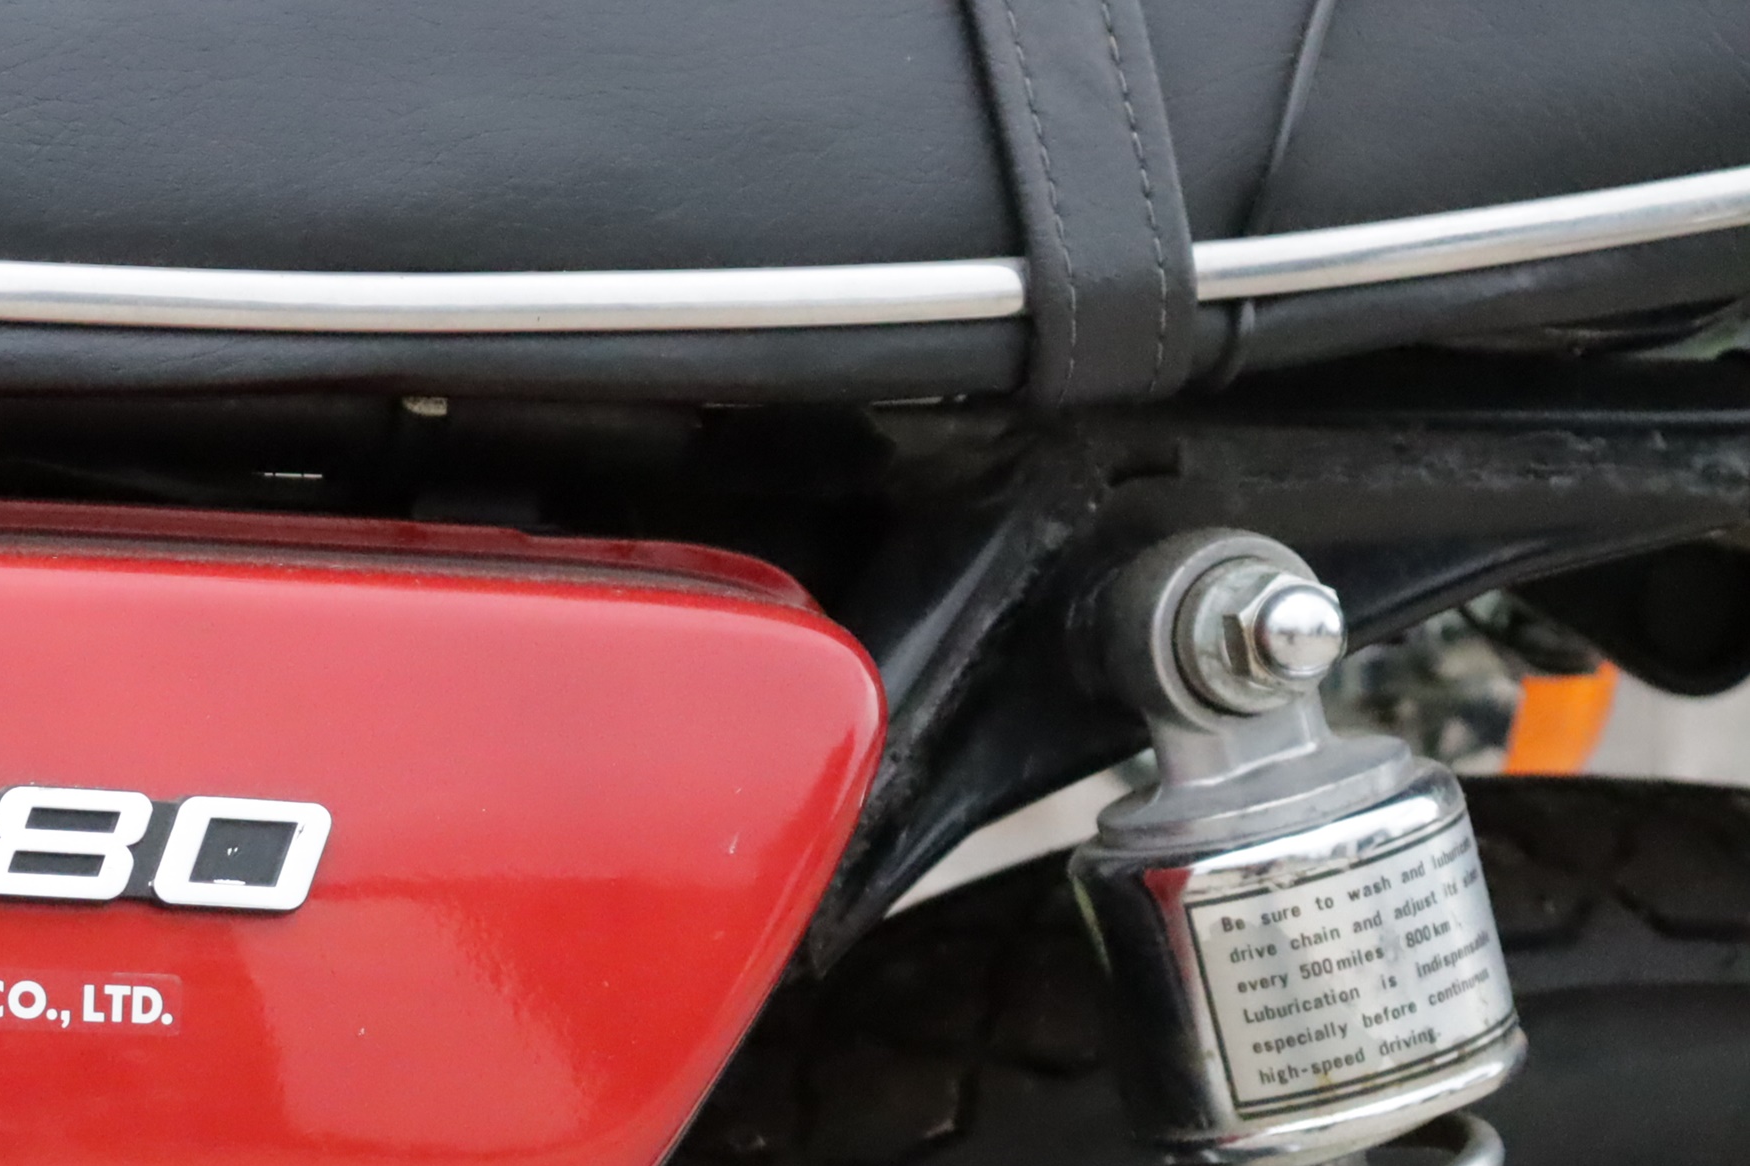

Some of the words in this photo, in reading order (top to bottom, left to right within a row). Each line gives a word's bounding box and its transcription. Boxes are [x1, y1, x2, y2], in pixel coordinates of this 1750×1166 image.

[1221, 916, 1246, 933] Be
[1261, 904, 1301, 926] sure
[1315, 896, 1334, 911] to
[1347, 875, 1392, 902] wash
[1401, 861, 1426, 884] and
[1230, 942, 1278, 963] drive
[1290, 926, 1341, 951] chain
[1353, 911, 1383, 934] and
[1394, 890, 1438, 921] adjust
[1238, 972, 1289, 994] every
[1243, 986, 1361, 1024] Luburication
[1381, 975, 1398, 990] is
[1253, 1021, 1349, 1054] especially
[1362, 1001, 1418, 1028] before
[1259, 1047, 1365, 1086] high-speed
[1378, 1026, 1442, 1057] driving.
